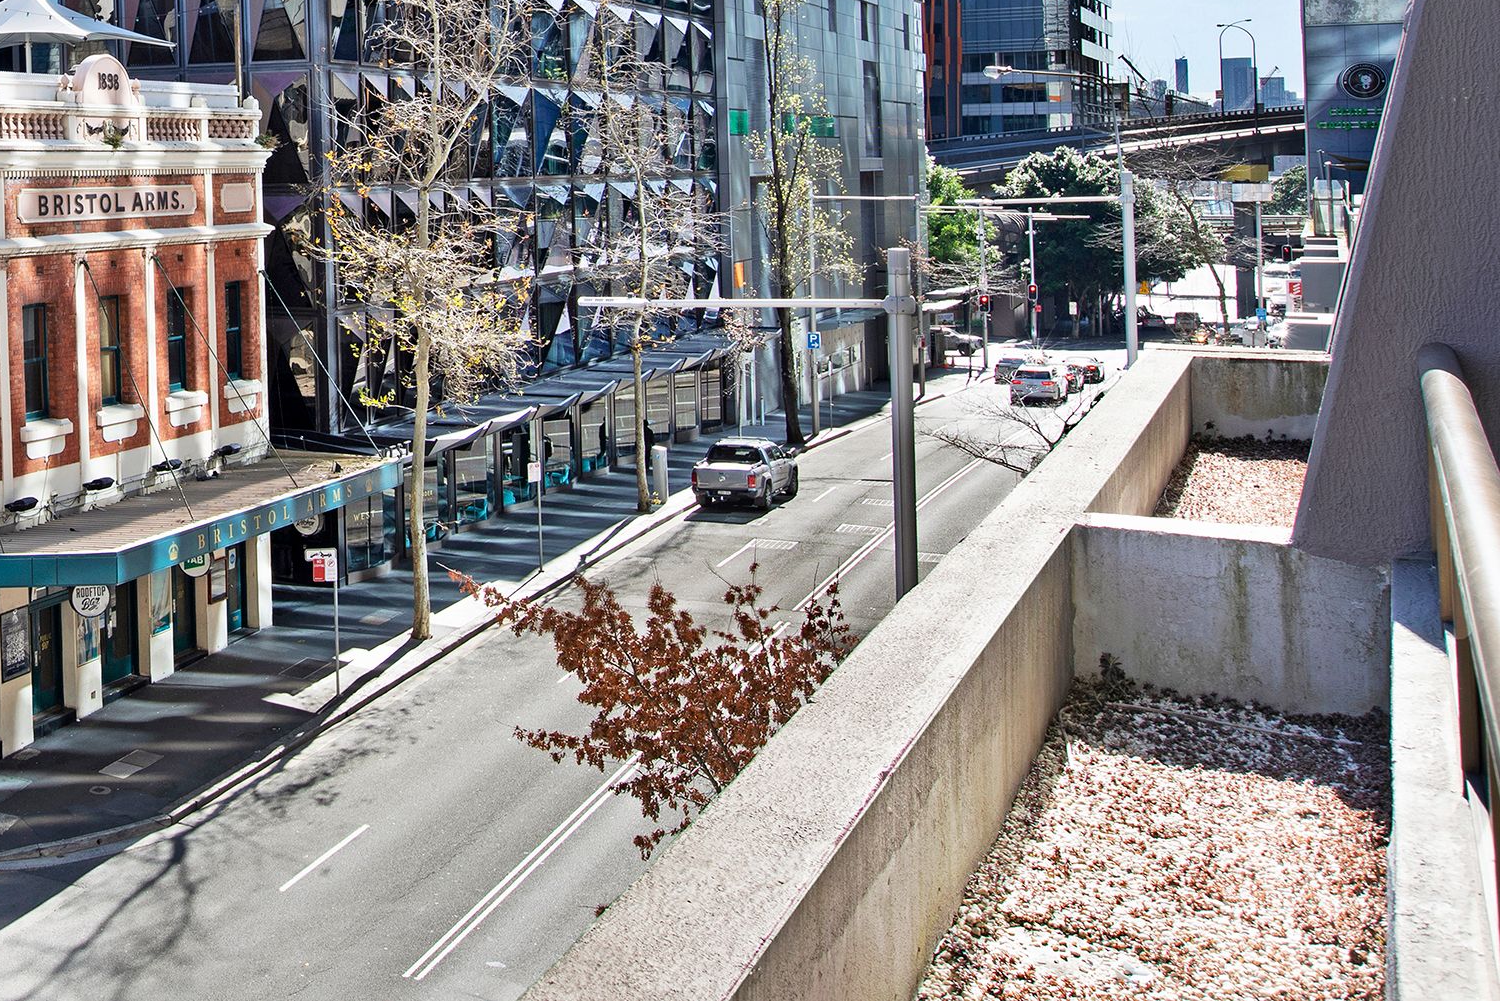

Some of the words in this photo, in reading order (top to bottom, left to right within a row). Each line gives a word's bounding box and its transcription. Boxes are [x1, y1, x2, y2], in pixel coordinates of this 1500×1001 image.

[98, 72, 119, 91] 1898
[38, 192, 126, 216] BRISTOL
[131, 190, 185, 212] ARMS.
[198, 504, 290, 549] BRISTOL
[306, 486, 352, 512] ARMS
[76, 586, 106, 598] ROOFTOP
